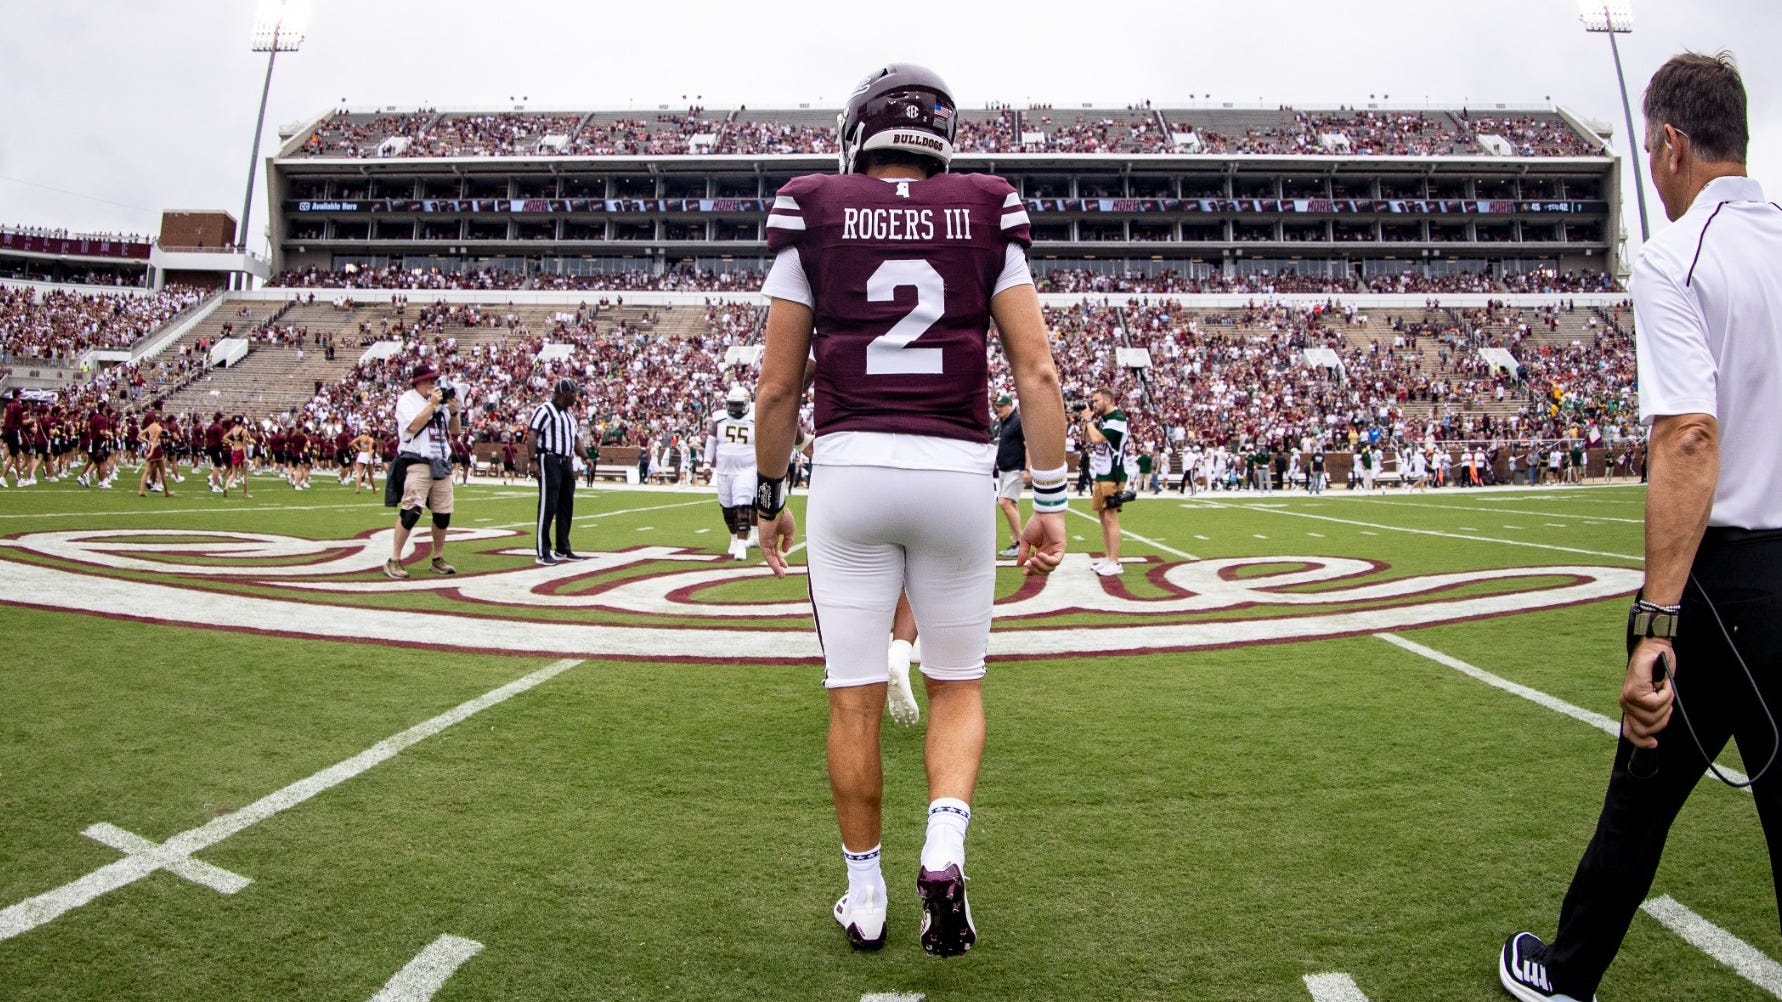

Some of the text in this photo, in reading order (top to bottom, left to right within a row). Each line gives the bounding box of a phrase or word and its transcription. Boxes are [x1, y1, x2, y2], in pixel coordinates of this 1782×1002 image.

[906, 105, 919, 119] SEC
[893, 134, 943, 151] BULLDOGS
[312, 202, 341, 210] Available
[342, 202, 357, 210] Here
[842, 208, 972, 240] ROGERS III
[867, 259, 945, 375] 2
[726, 426, 749, 444] 55
